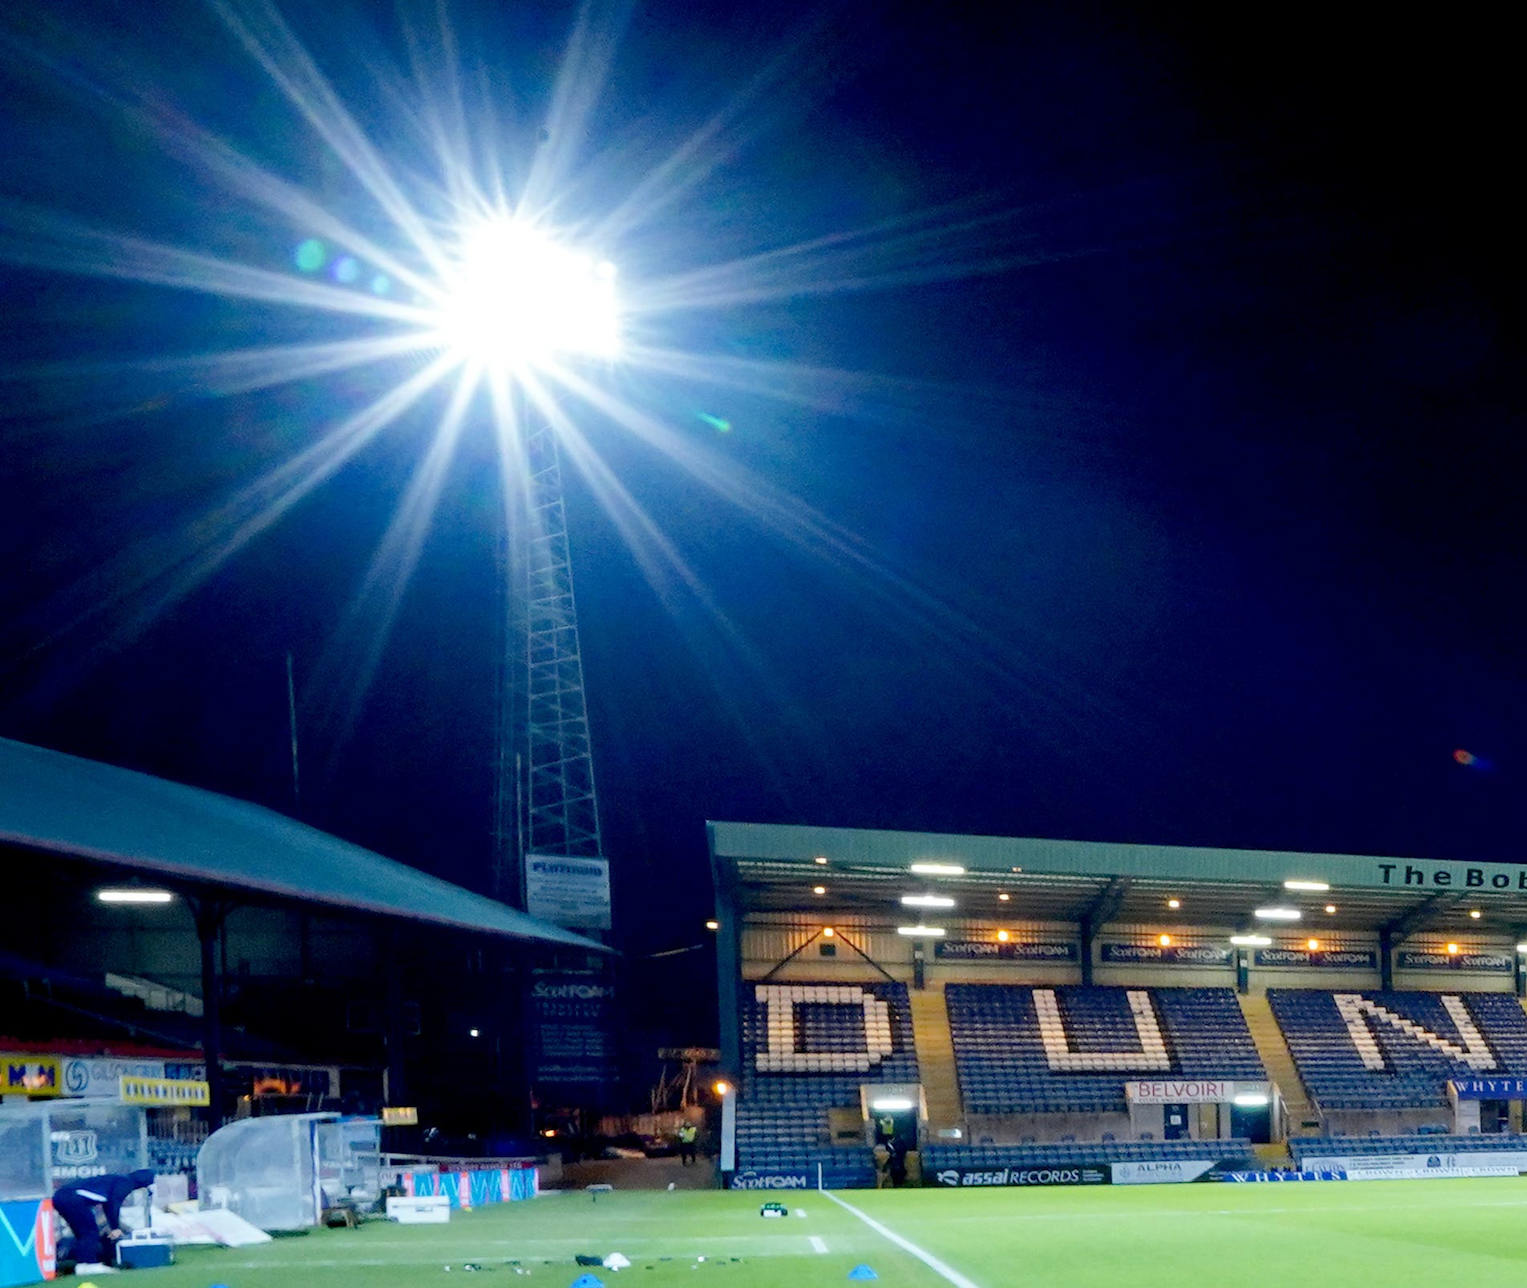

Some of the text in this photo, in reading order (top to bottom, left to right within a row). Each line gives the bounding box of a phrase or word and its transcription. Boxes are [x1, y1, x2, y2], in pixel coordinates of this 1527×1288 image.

[1379, 864, 1452, 886] The
[9, 1064, 55, 1087] MM
[1137, 1163, 1183, 1171] ALPHA
[731, 1174, 807, 1189] ScotFOAM
[1010, 1168, 1079, 1184] RECORDS
